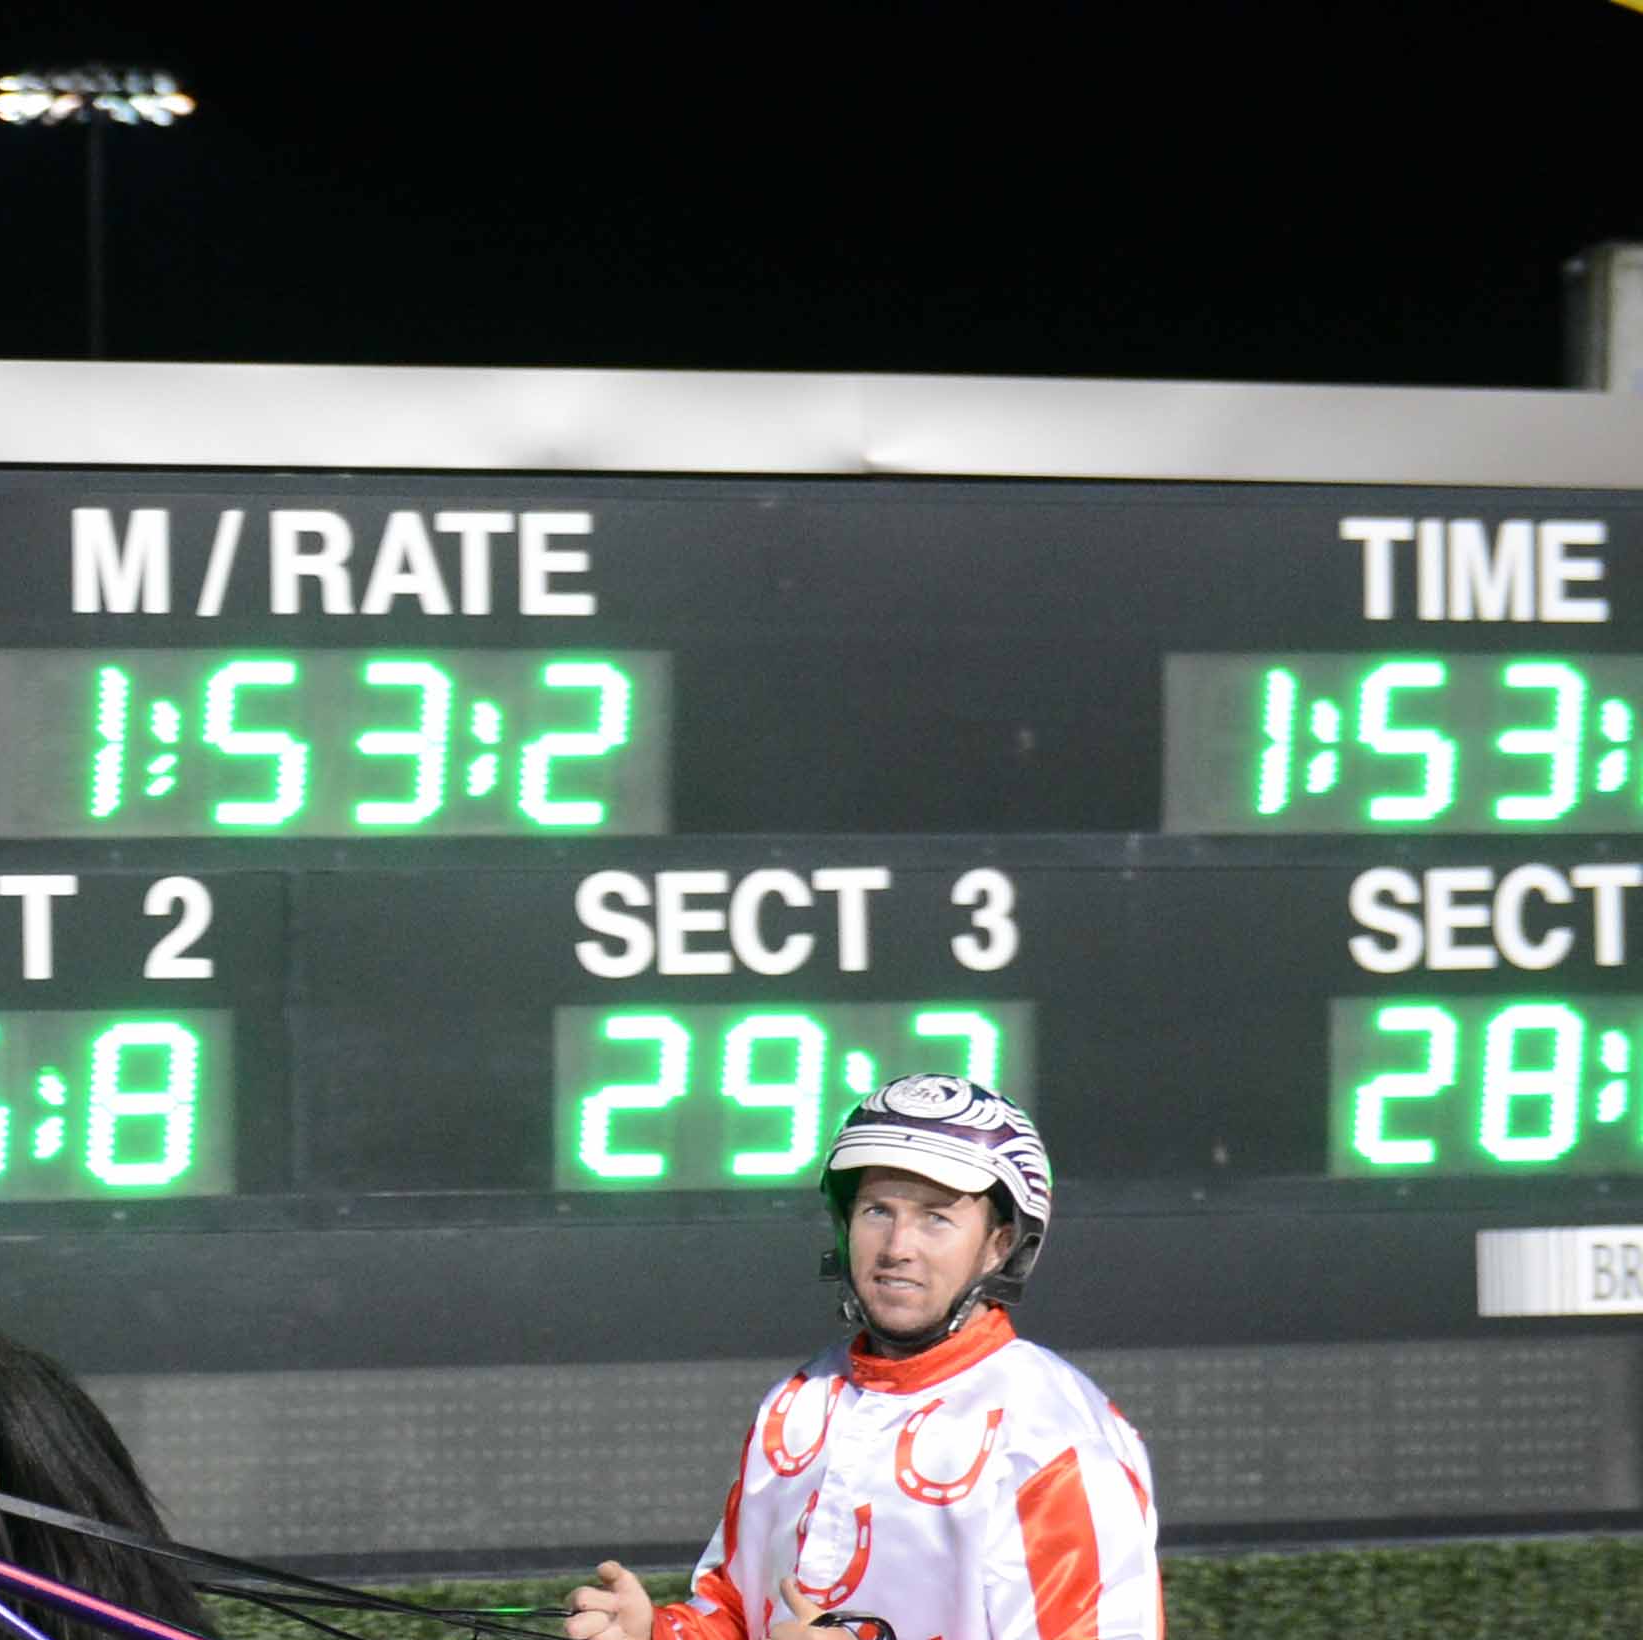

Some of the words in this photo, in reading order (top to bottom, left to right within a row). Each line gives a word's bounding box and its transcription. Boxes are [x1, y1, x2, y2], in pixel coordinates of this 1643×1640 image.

[1340, 517, 1608, 622] TIME
[1256, 660, 1643, 823] 1:53:
[143, 875, 214, 979] 2
[574, 866, 891, 979] SECT
[950, 868, 1019, 971] 3
[1348, 864, 1643, 973] SECT
[1350, 1004, 1643, 1166] 28:
